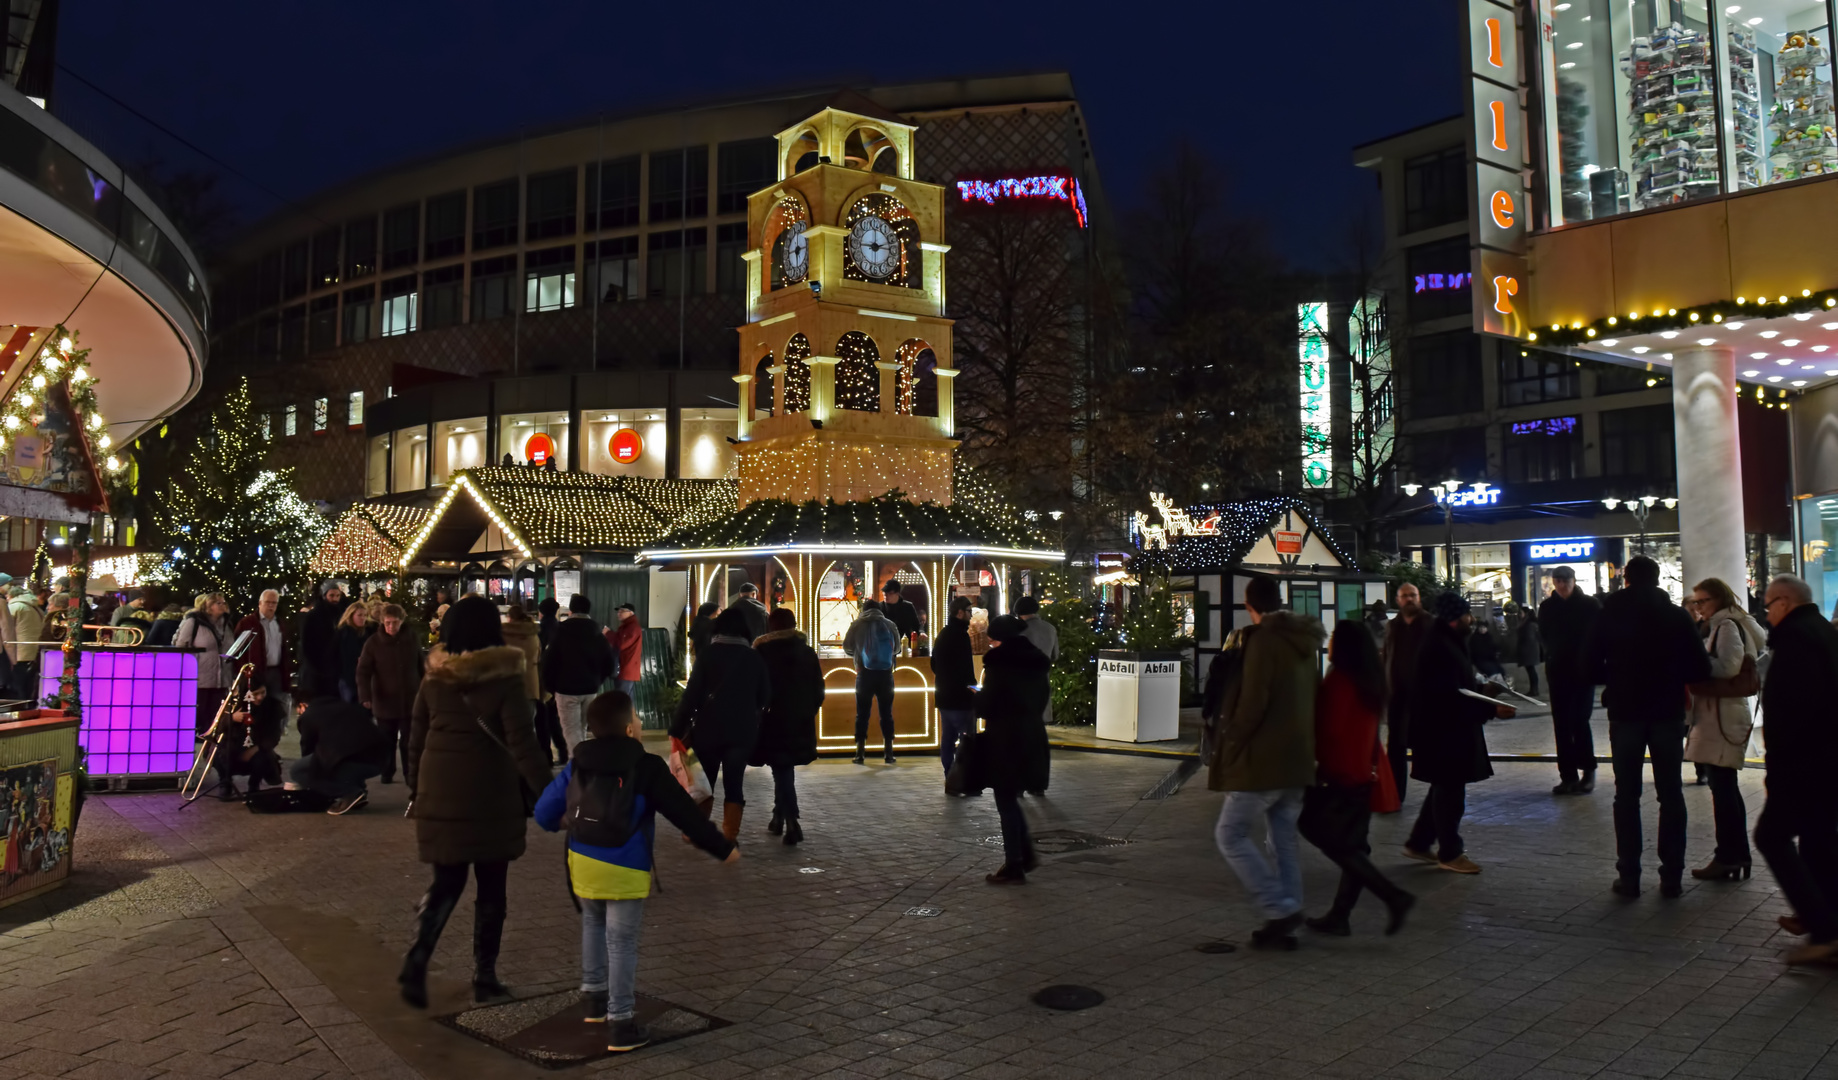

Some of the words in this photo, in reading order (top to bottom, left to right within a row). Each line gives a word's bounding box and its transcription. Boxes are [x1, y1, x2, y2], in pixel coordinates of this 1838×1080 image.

[1530, 543, 1594, 558] DEPOT
[1100, 662, 1135, 674] Abfall
[1144, 663, 1175, 674] Abfall
